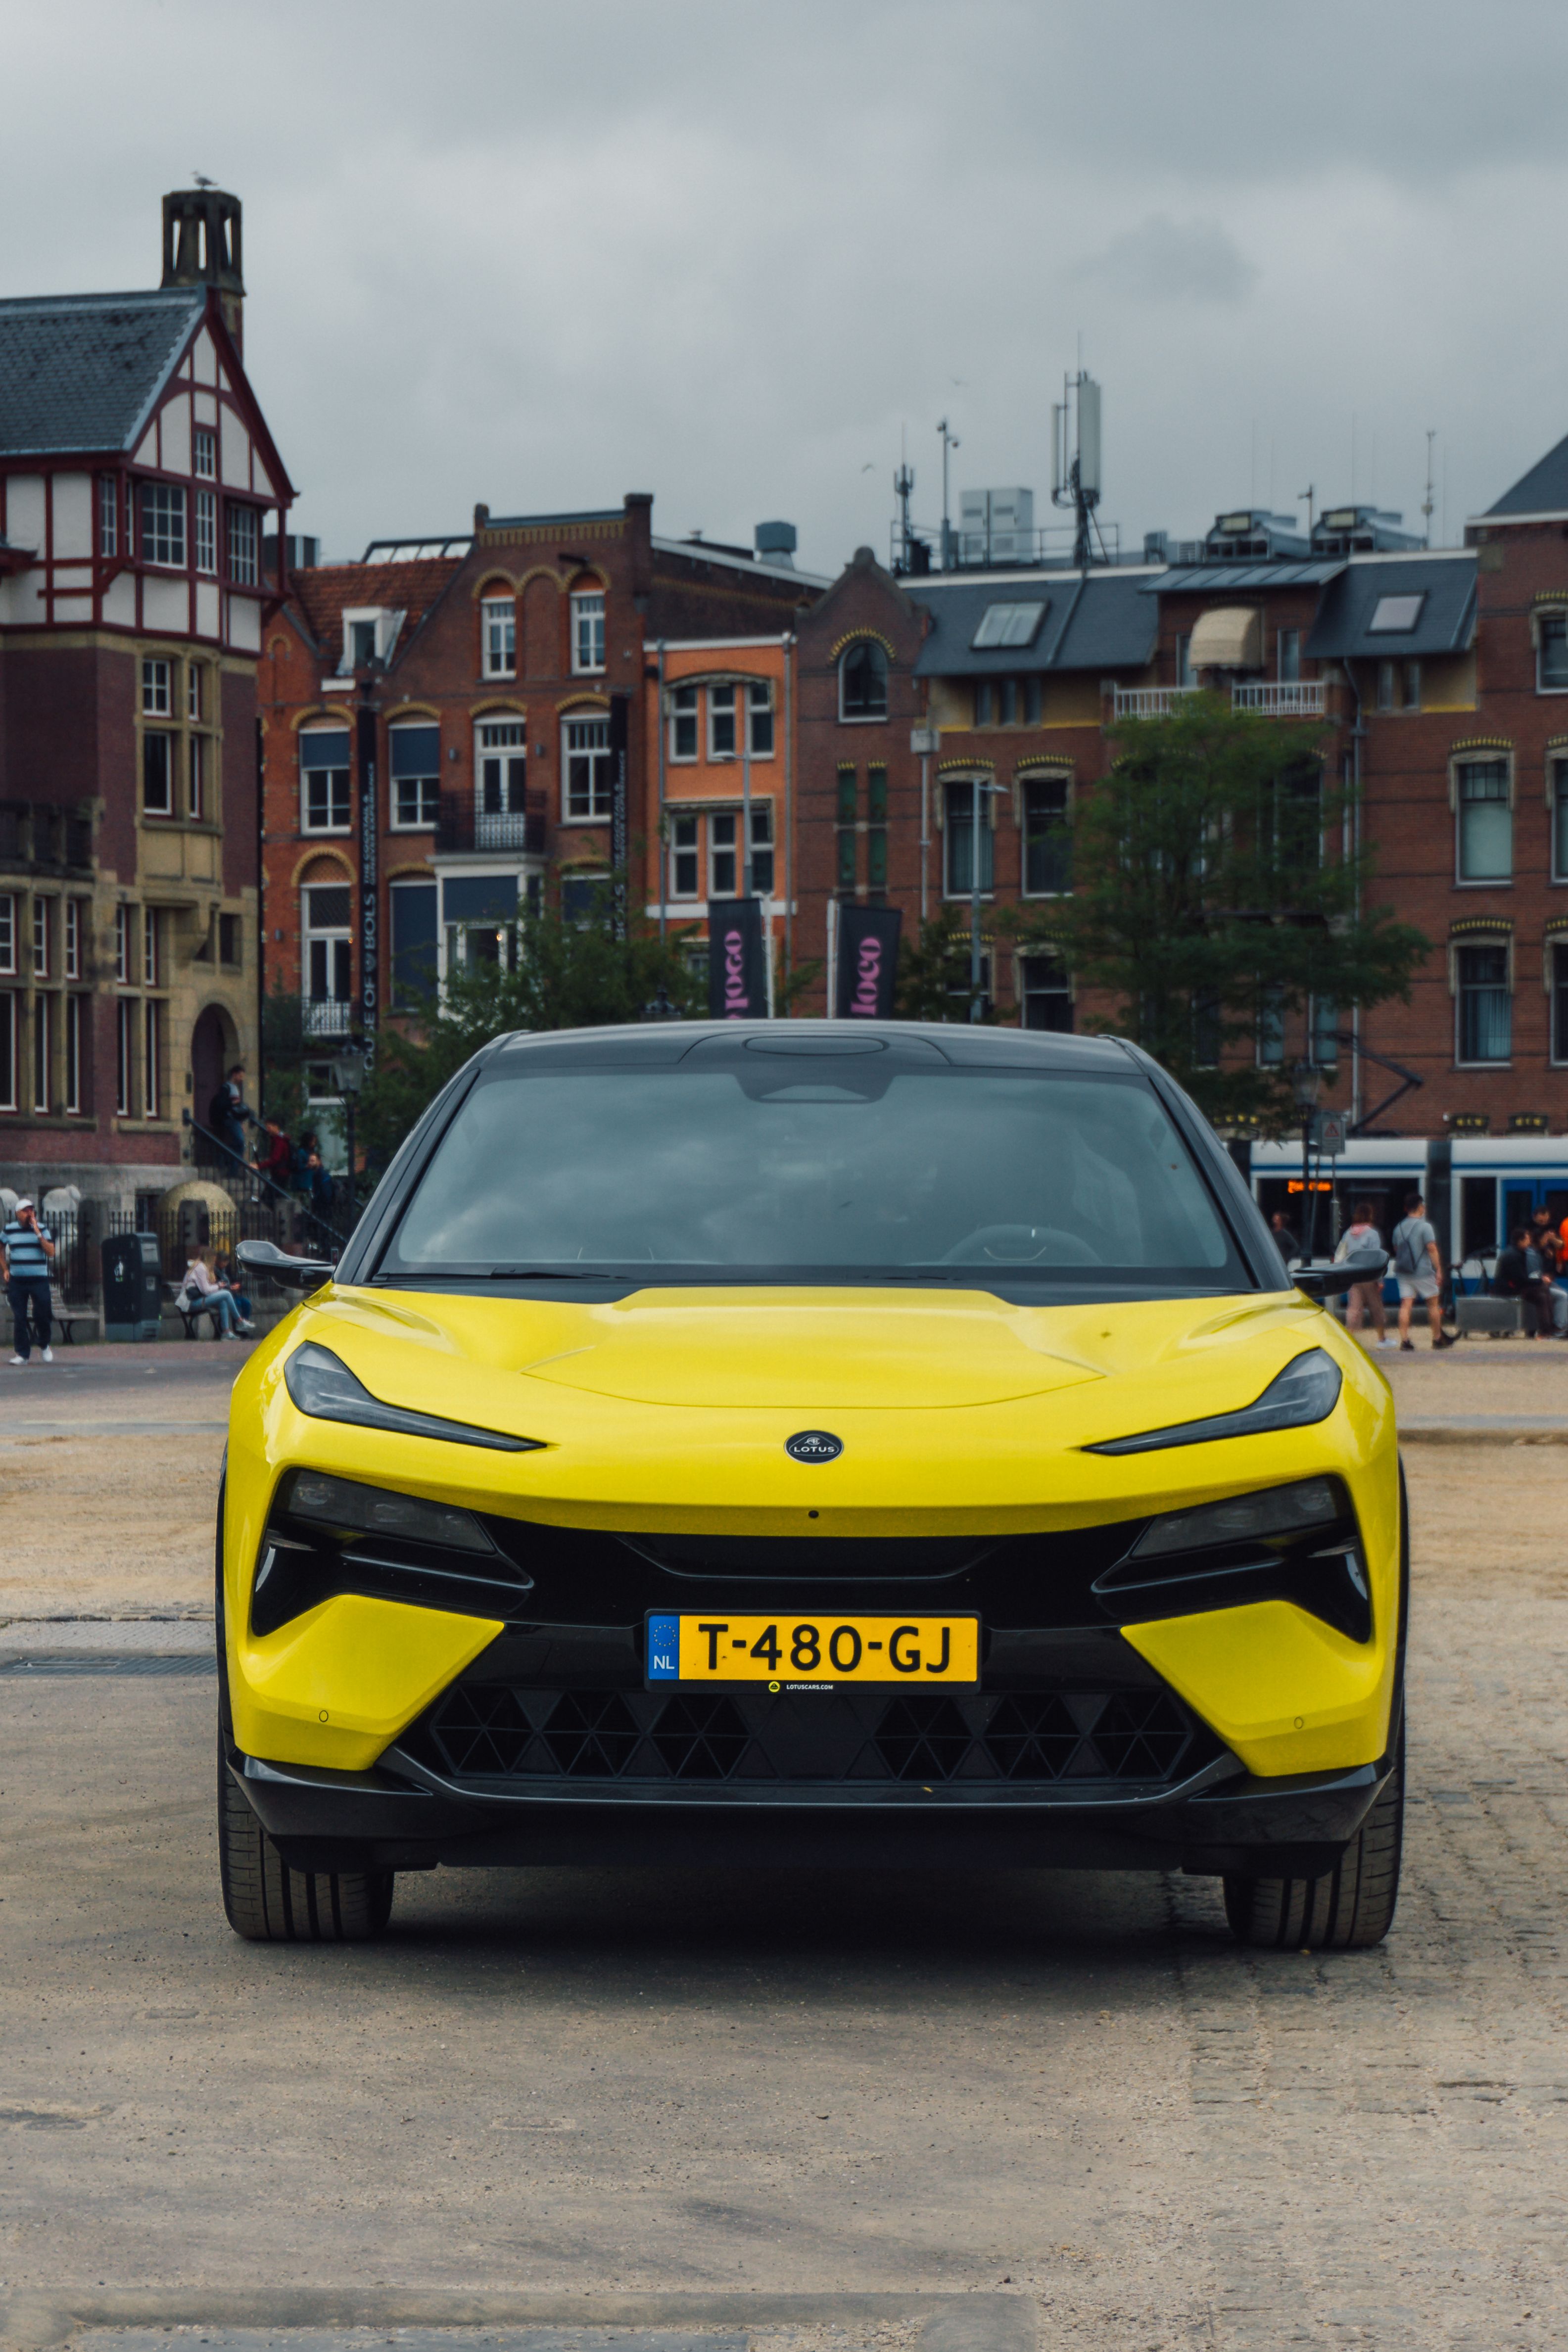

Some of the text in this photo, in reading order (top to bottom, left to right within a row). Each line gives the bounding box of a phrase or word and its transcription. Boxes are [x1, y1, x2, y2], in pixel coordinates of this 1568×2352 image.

[364, 894, 376, 950] BOLS
[364, 975, 375, 1008] OF
[653, 1655, 675, 1670] NL
[698, 1623, 950, 1673] T-480-GJ
